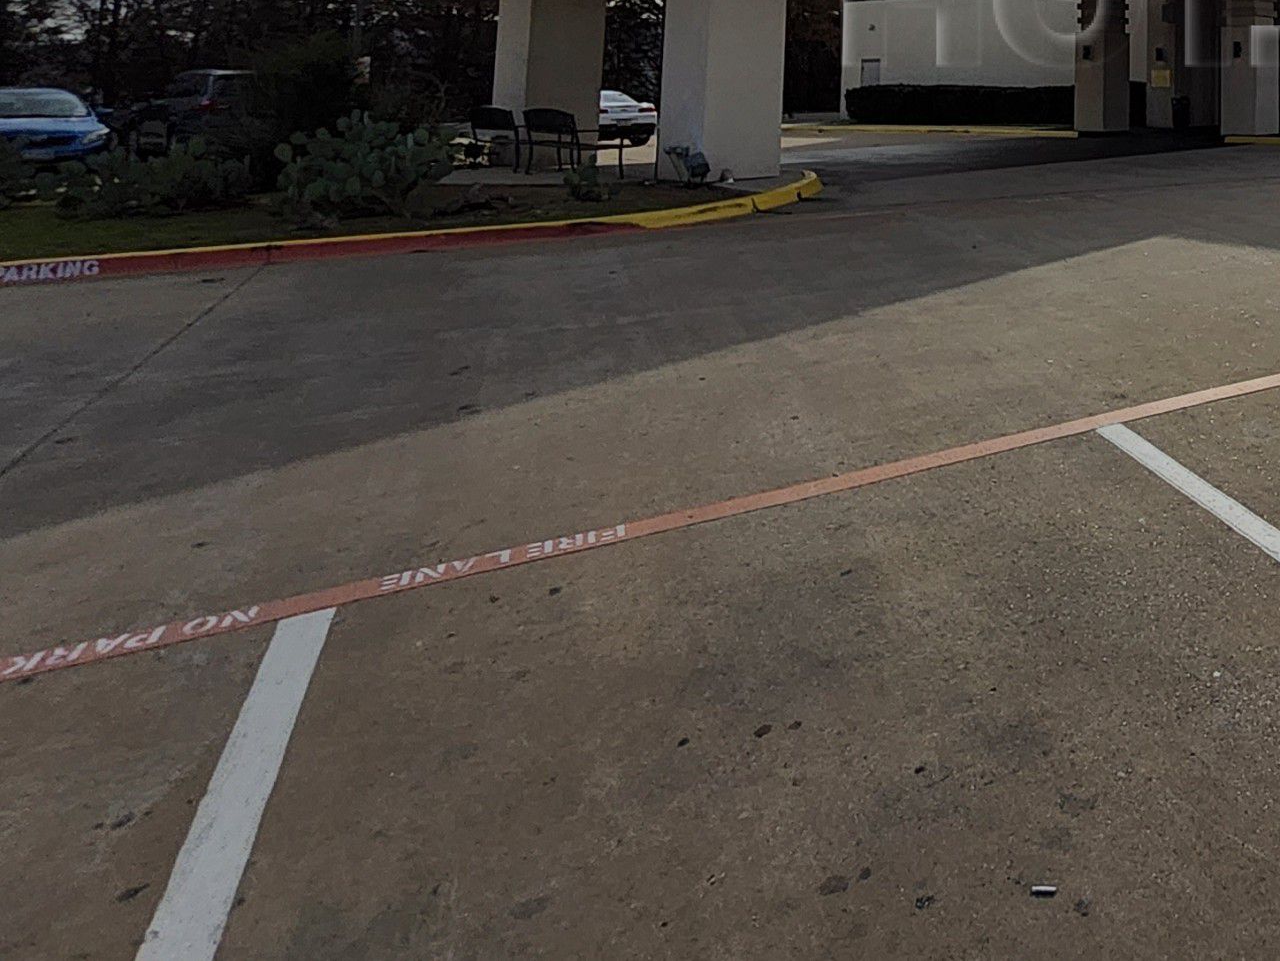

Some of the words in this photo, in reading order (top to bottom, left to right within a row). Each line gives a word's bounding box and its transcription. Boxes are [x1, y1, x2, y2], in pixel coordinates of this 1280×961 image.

[526, 524, 626, 559] FIRE
[380, 548, 512, 590] LANE
[182, 605, 260, 635] NO
